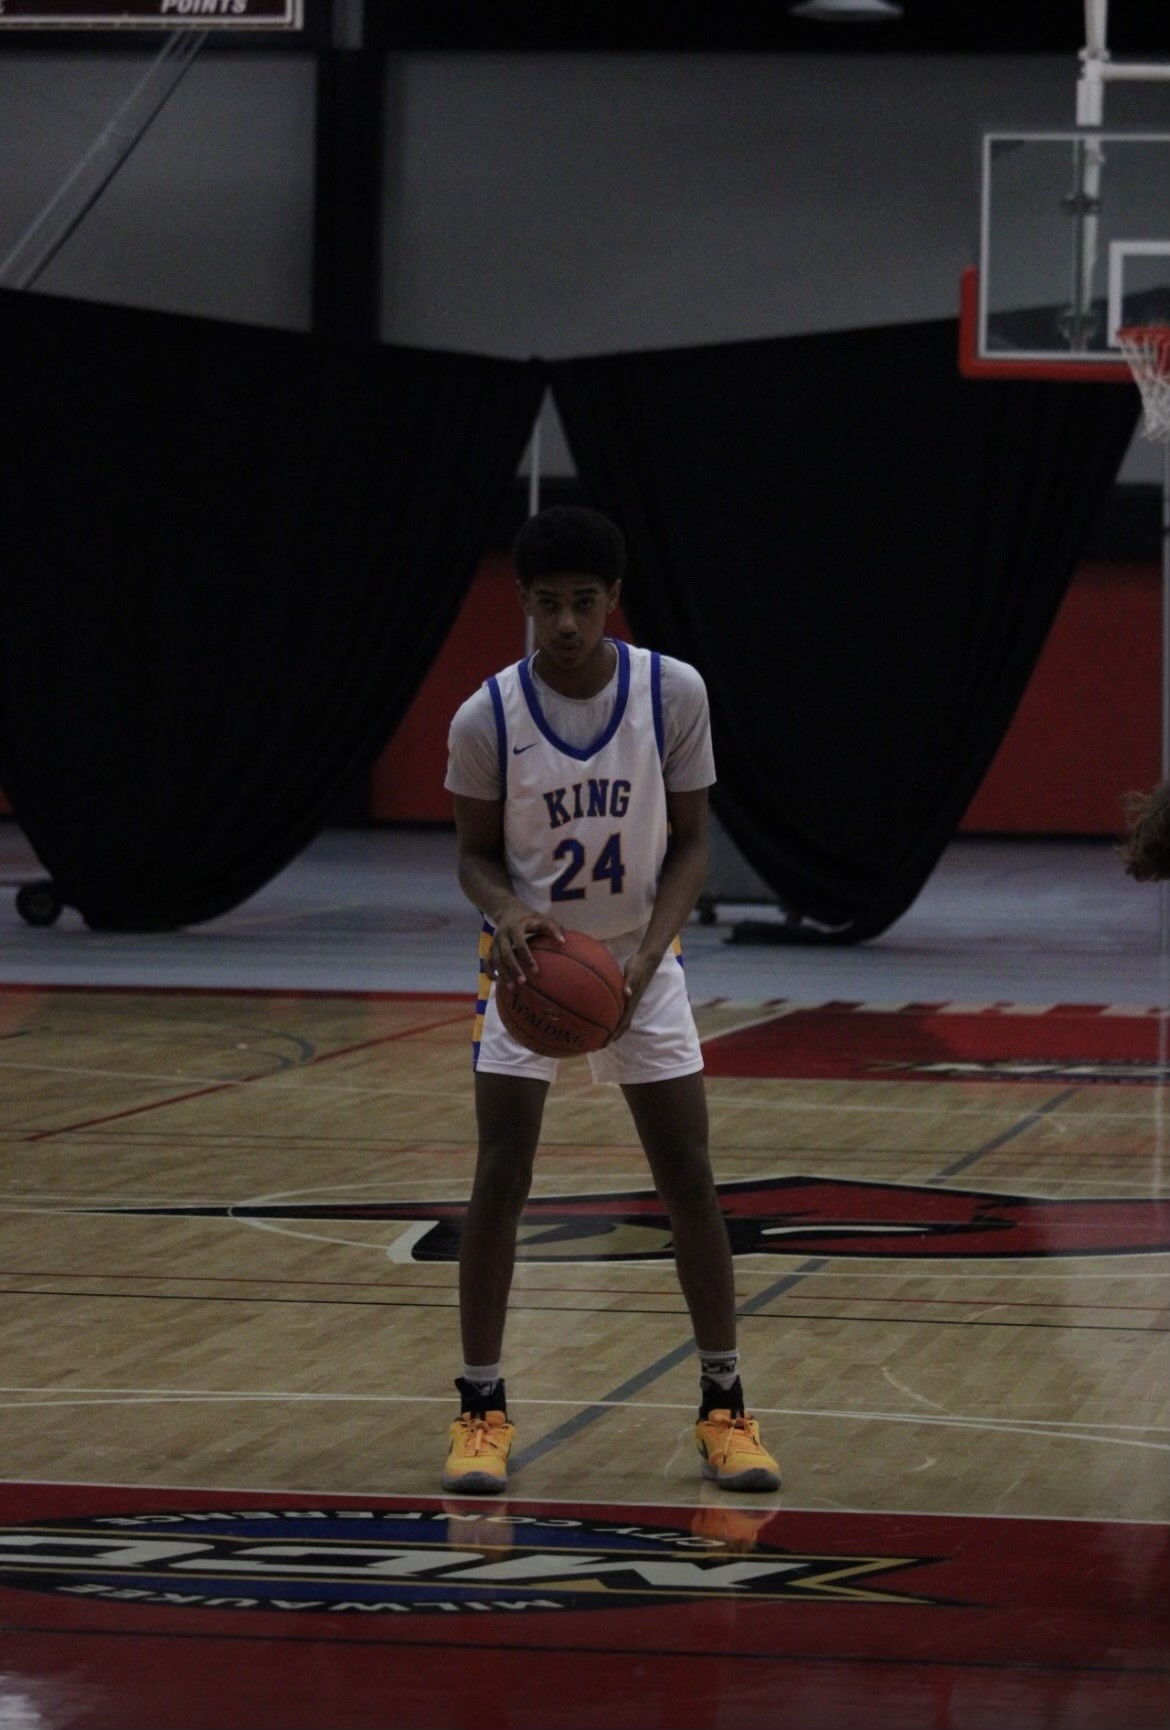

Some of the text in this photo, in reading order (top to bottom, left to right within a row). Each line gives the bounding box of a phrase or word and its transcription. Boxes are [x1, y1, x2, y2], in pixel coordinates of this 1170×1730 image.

[543, 779, 632, 830] KING
[551, 832, 626, 902] 24
[95, 1510, 727, 1548] CITY CONFERENCE
[0, 1535, 813, 1588] MCC
[58, 1584, 564, 1612] MILWAUKEE
